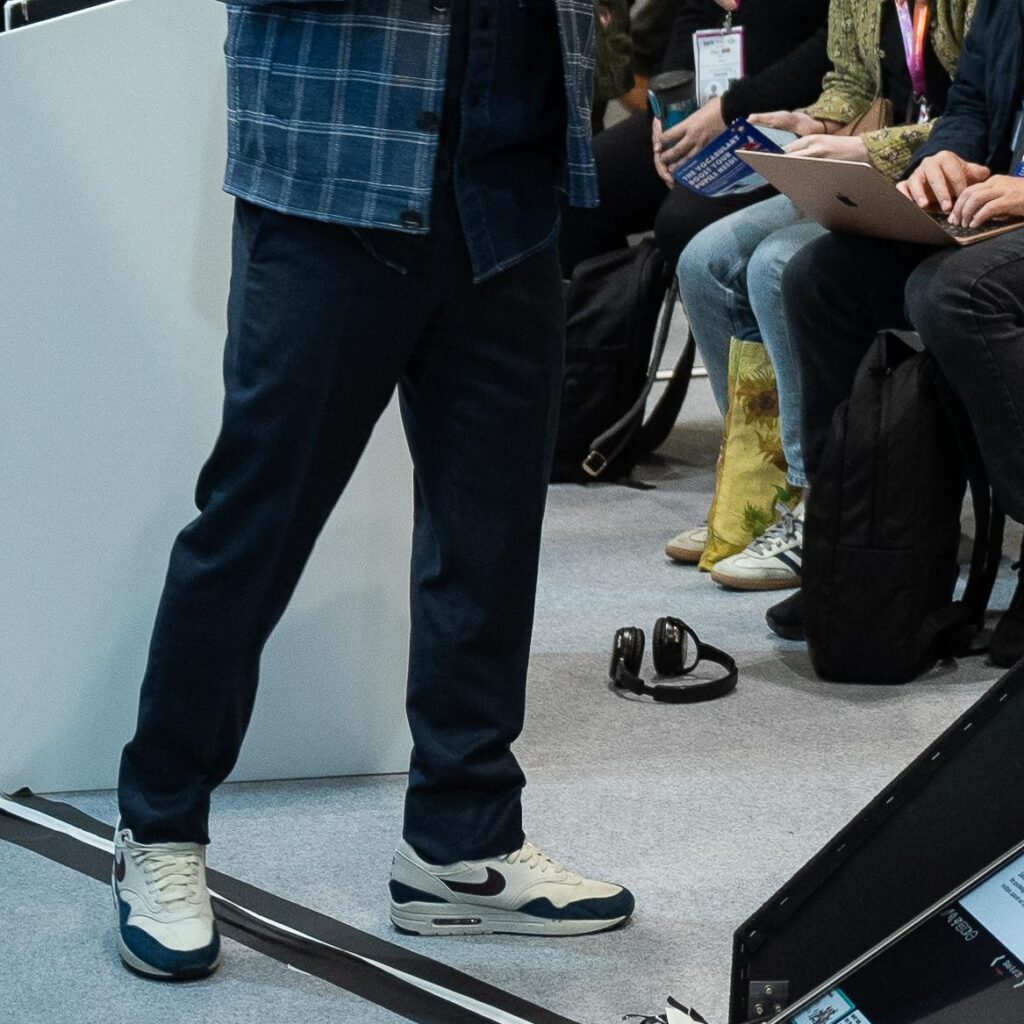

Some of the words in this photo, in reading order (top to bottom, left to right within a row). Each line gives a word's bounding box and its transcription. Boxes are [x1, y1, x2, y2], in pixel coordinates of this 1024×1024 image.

[688, 167, 712, 186] BOOST
[712, 152, 732, 169] YOUR
[696, 135, 740, 171] VOCABULARY
[694, 170, 719, 189] PUPILS
